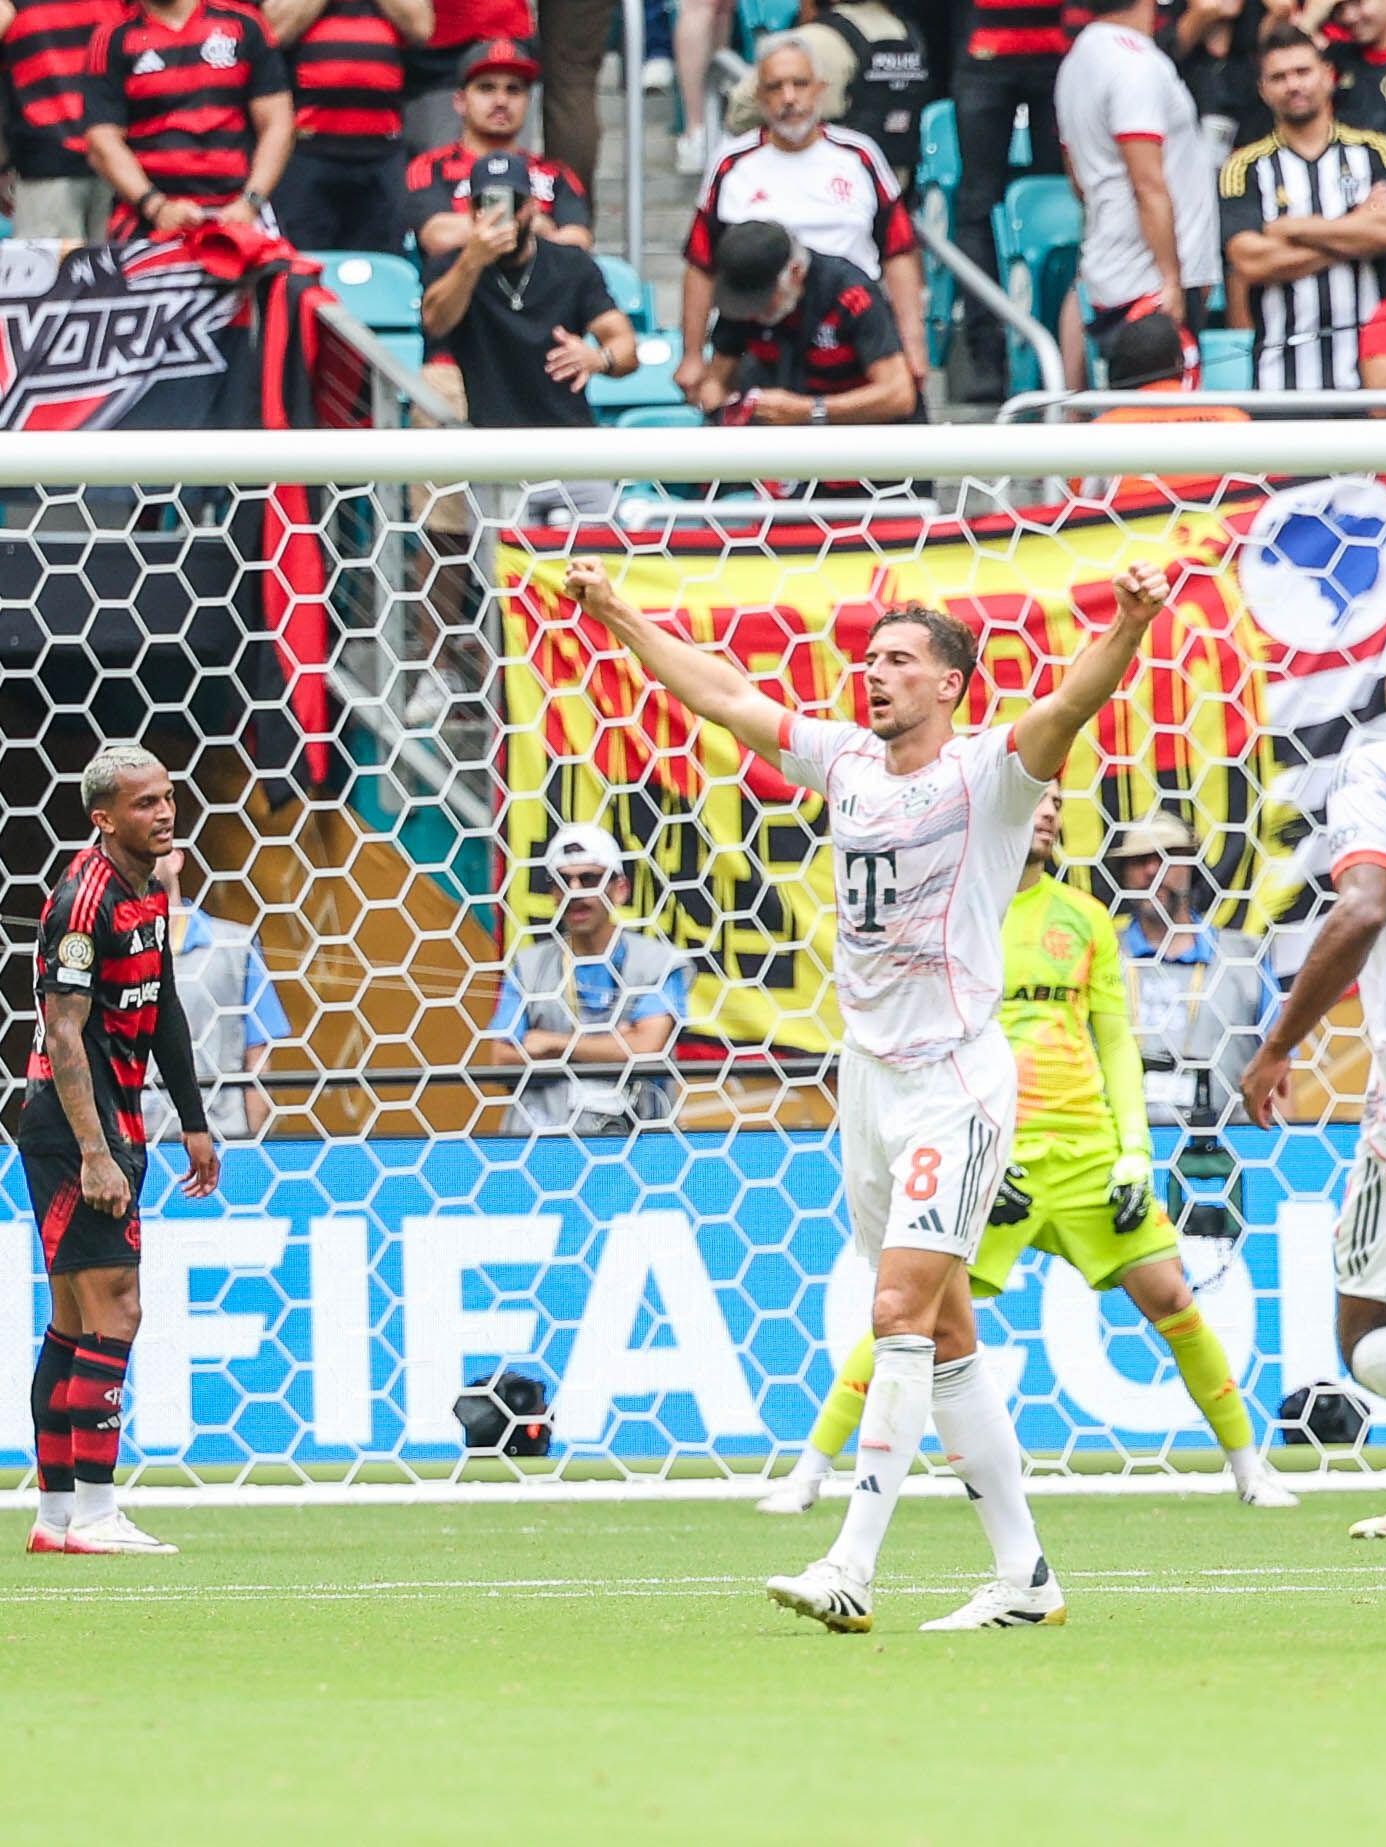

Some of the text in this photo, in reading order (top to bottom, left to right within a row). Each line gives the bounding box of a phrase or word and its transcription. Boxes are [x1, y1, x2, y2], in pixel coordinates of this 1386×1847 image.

[2, 290, 226, 380] YORK
[904, 1147, 942, 1202] 8
[134, 1210, 765, 1449] FIFA
